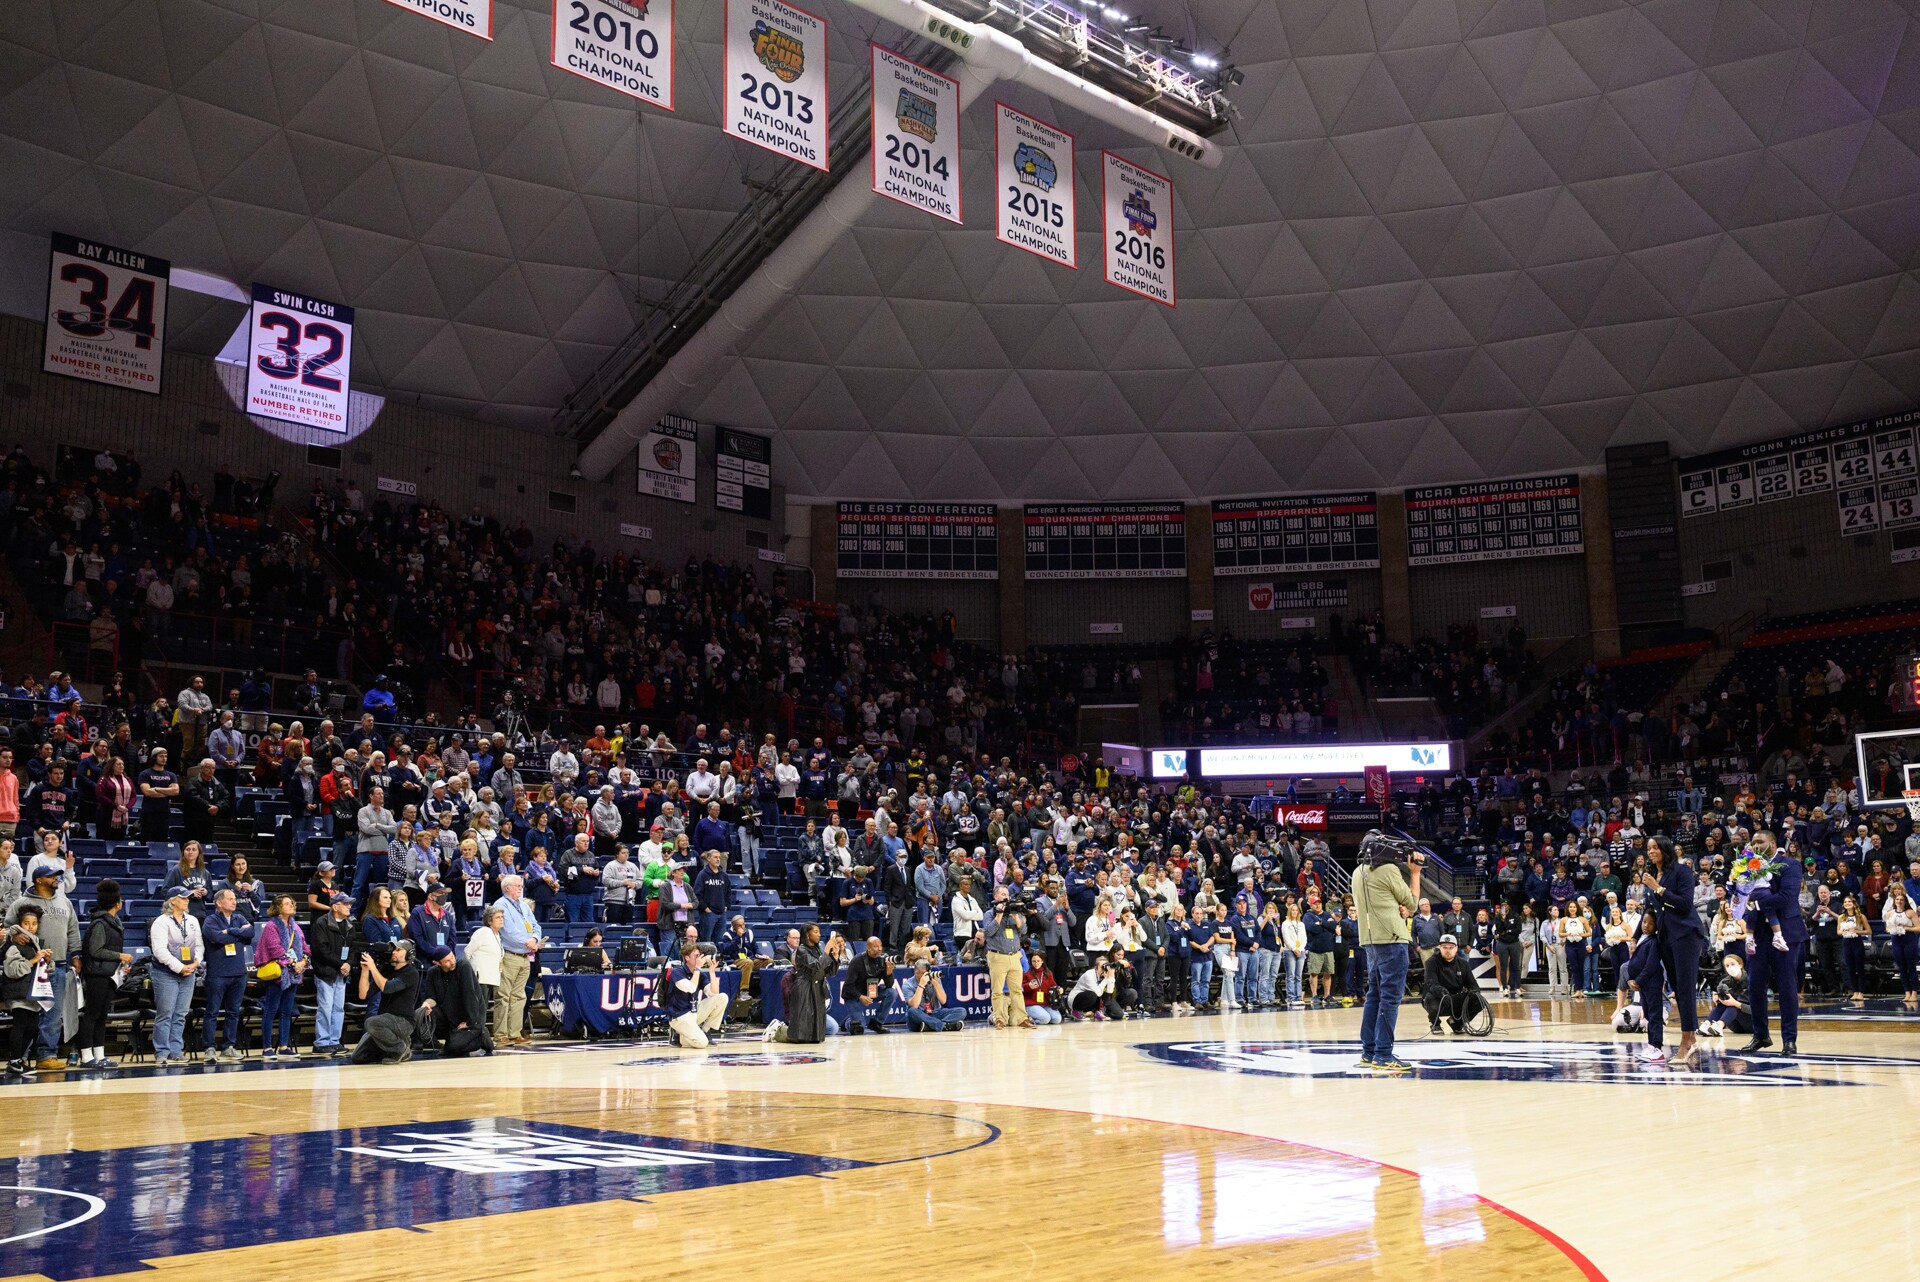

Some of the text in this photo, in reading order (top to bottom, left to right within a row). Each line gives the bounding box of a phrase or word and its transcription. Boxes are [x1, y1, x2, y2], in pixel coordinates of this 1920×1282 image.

[752, 5, 802, 35] Basketball
[774, 1, 816, 28] Women's
[570, 1, 658, 59] 2010
[770, 29, 803, 51] FINAL
[576, 38, 653, 78] NATIONAL
[757, 34, 804, 67] FOUR
[568, 54, 659, 98] CHAMPIONS
[881, 52, 950, 90] UConn Women's
[895, 71, 938, 97] Basketball
[741, 73, 813, 124] 2013
[910, 96, 935, 113] FINAL
[744, 106, 810, 142] NATIONAL
[900, 102, 936, 127] FOUR
[901, 118, 933, 136] NASHVILLE
[1004, 109, 1066, 143] UConn Women's
[738, 122, 815, 160] CHAMPIONS
[1016, 126, 1055, 150] Basketball
[886, 134, 949, 181] 2014
[890, 166, 946, 197] NATIONAL
[1020, 171, 1037, 186] TAMPA
[1110, 158, 1165, 188] UConn Women's
[1121, 174, 1155, 195] Basketball
[884, 181, 951, 214] CHAMPIONS
[1008, 186, 1063, 227] 2015
[1125, 206, 1154, 225] FINAL FOUR
[1012, 215, 1063, 243] NATIONAL
[1007, 229, 1067, 259] CHAMPIONS
[1115, 230, 1165, 269] 2016
[78, 242, 145, 270] RAY ALLEN
[1118, 258, 1163, 284] NATIONAL
[1114, 271, 1167, 299] CHAMPIONS
[57, 263, 155, 350] 34
[274, 292, 334, 317] SWIN CASH
[60, 346, 99, 360] BASKETBALL
[103, 355, 118, 364] HALL
[131, 360, 147, 370] FAME
[71, 340, 137, 360] NAISMITH MEMORIAL
[258, 311, 344, 393] 32
[51, 355, 154, 382] NUMBER RETIRED
[74, 369, 100, 378] MARCH
[261, 389, 295, 401] BASKETBALL
[298, 397, 310, 405] HALL
[322, 402, 336, 410] FAME
[270, 383, 327, 400] NAISMITH MEMORIAL
[253, 397, 341, 421] NUMBER RETIRED
[264, 408, 300, 419] NOVEMBER
[1743, 412, 1920, 456] UCONN HUSKIES OF HONOR
[1841, 458, 1869, 477] 42
[1882, 449, 1911, 469] 44
[1761, 474, 1787, 494] 22
[1799, 466, 1827, 486] 25
[396, 483, 415, 493] 210
[1415, 488, 1571, 508] TOURNAMENT APPEARANCES
[1416, 478, 1568, 498] NCAA CHAMPIONSHIP
[1731, 483, 1740, 499] 9
[841, 504, 993, 514] BIG EAST CONFERENCE
[1262, 499, 1308, 507] INVITATION
[1312, 496, 1368, 504] TOURNAMENT
[1691, 491, 1706, 507] C
[1889, 499, 1913, 518] 13
[1257, 507, 1331, 516] APPEARANCES
[1411, 504, 1500, 522] 1951 1954 1957
[1845, 506, 1873, 526] 24
[639, 528, 650, 537] 211
[864, 524, 995, 536] 1994 1995 2002
[1216, 520, 1279, 533] 1955 1974 1975
[1435, 520, 1501, 536] 1964 1967
[886, 541, 903, 551] 2006
[1263, 532, 1351, 546] 1997 2015
[1412, 539, 1478, 554] 1991 1992 1994
[772, 553, 785, 561] 212
[1414, 554, 1479, 564] CONNECTICUT
[1517, 546, 1578, 556] BASKETBALL
[1219, 566, 1281, 574] CONNECTICUT
[1254, 593, 1270, 601] NIT
[1698, 583, 1715, 592] 213
[1275, 598, 1348, 608] TOURNAMENT CHAMPION
[654, 769, 674, 779] 110
[961, 820, 973, 828] 32
[1285, 810, 1326, 824] Coca-Cola
[183, 876, 206, 886] UCONN
[467, 882, 482, 897] 32
